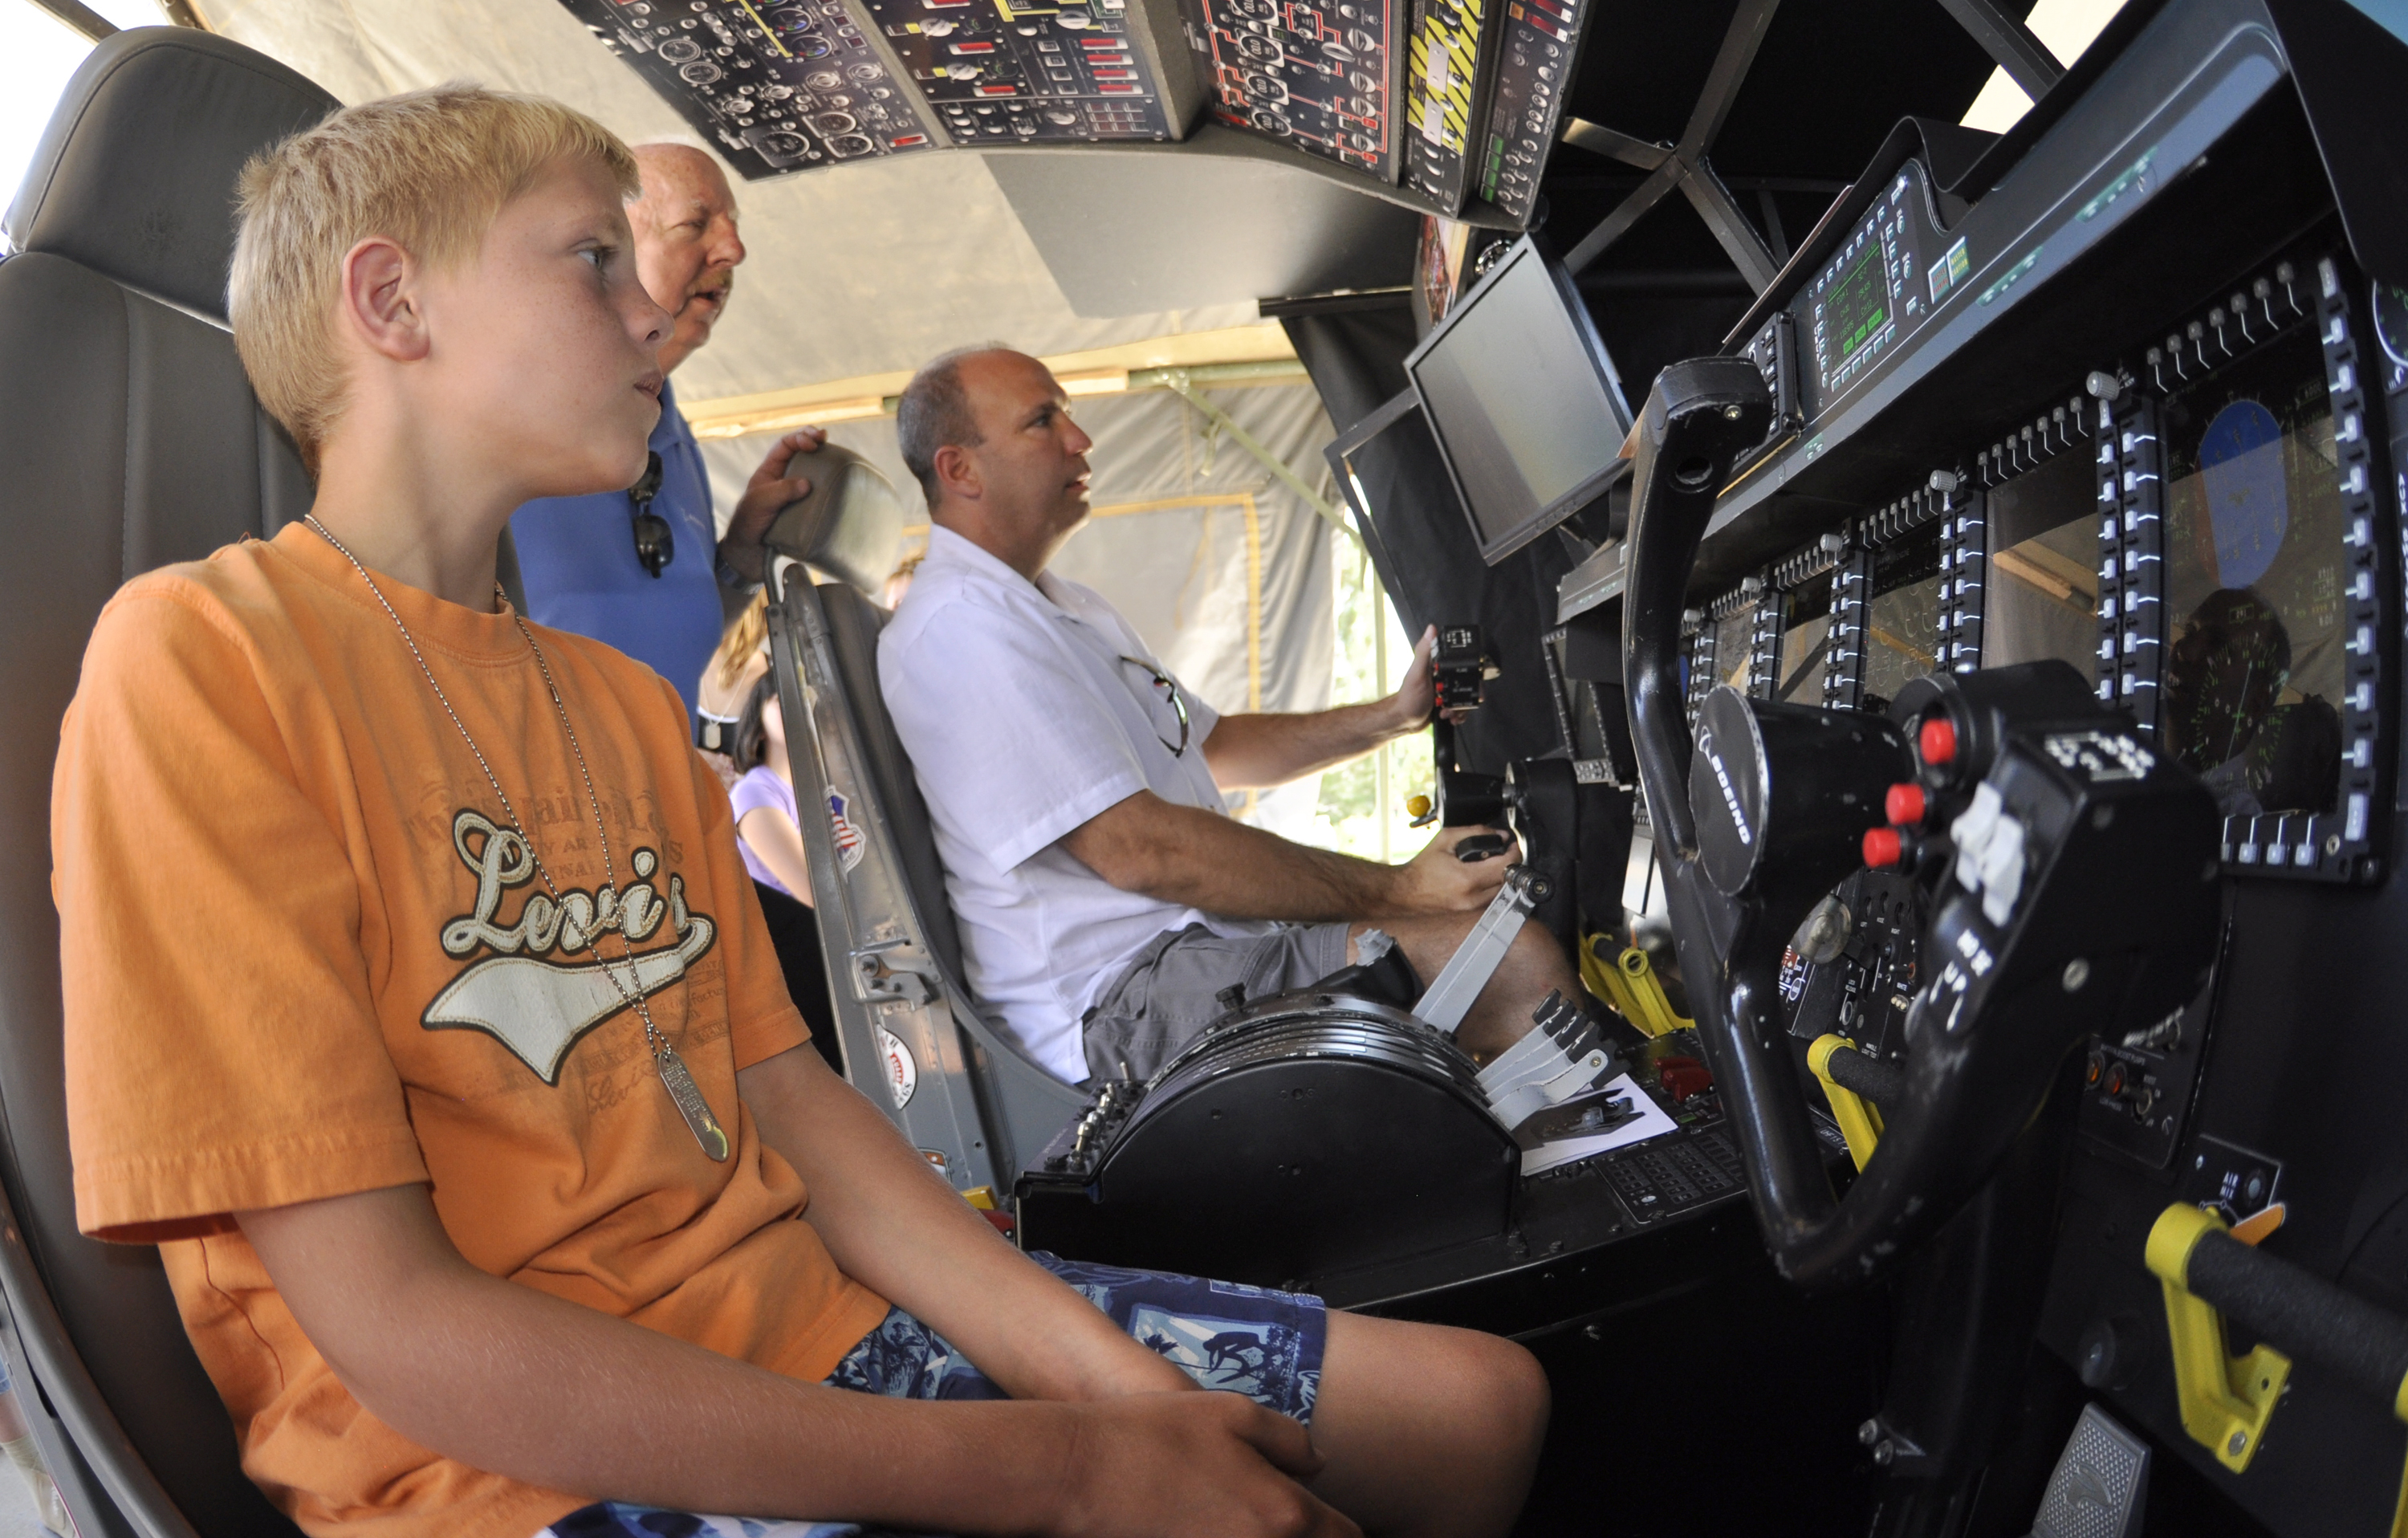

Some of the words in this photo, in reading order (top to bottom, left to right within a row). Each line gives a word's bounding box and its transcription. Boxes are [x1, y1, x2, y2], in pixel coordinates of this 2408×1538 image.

[1548, 1005, 1563, 1024] 2
[1561, 1015, 1577, 1034] 3
[1572, 1031, 1588, 1050] 4
[890, 1055, 903, 1084] GUARD
[2223, 1170, 2239, 1188] AIR
[2219, 1185, 2235, 1200] MIX
